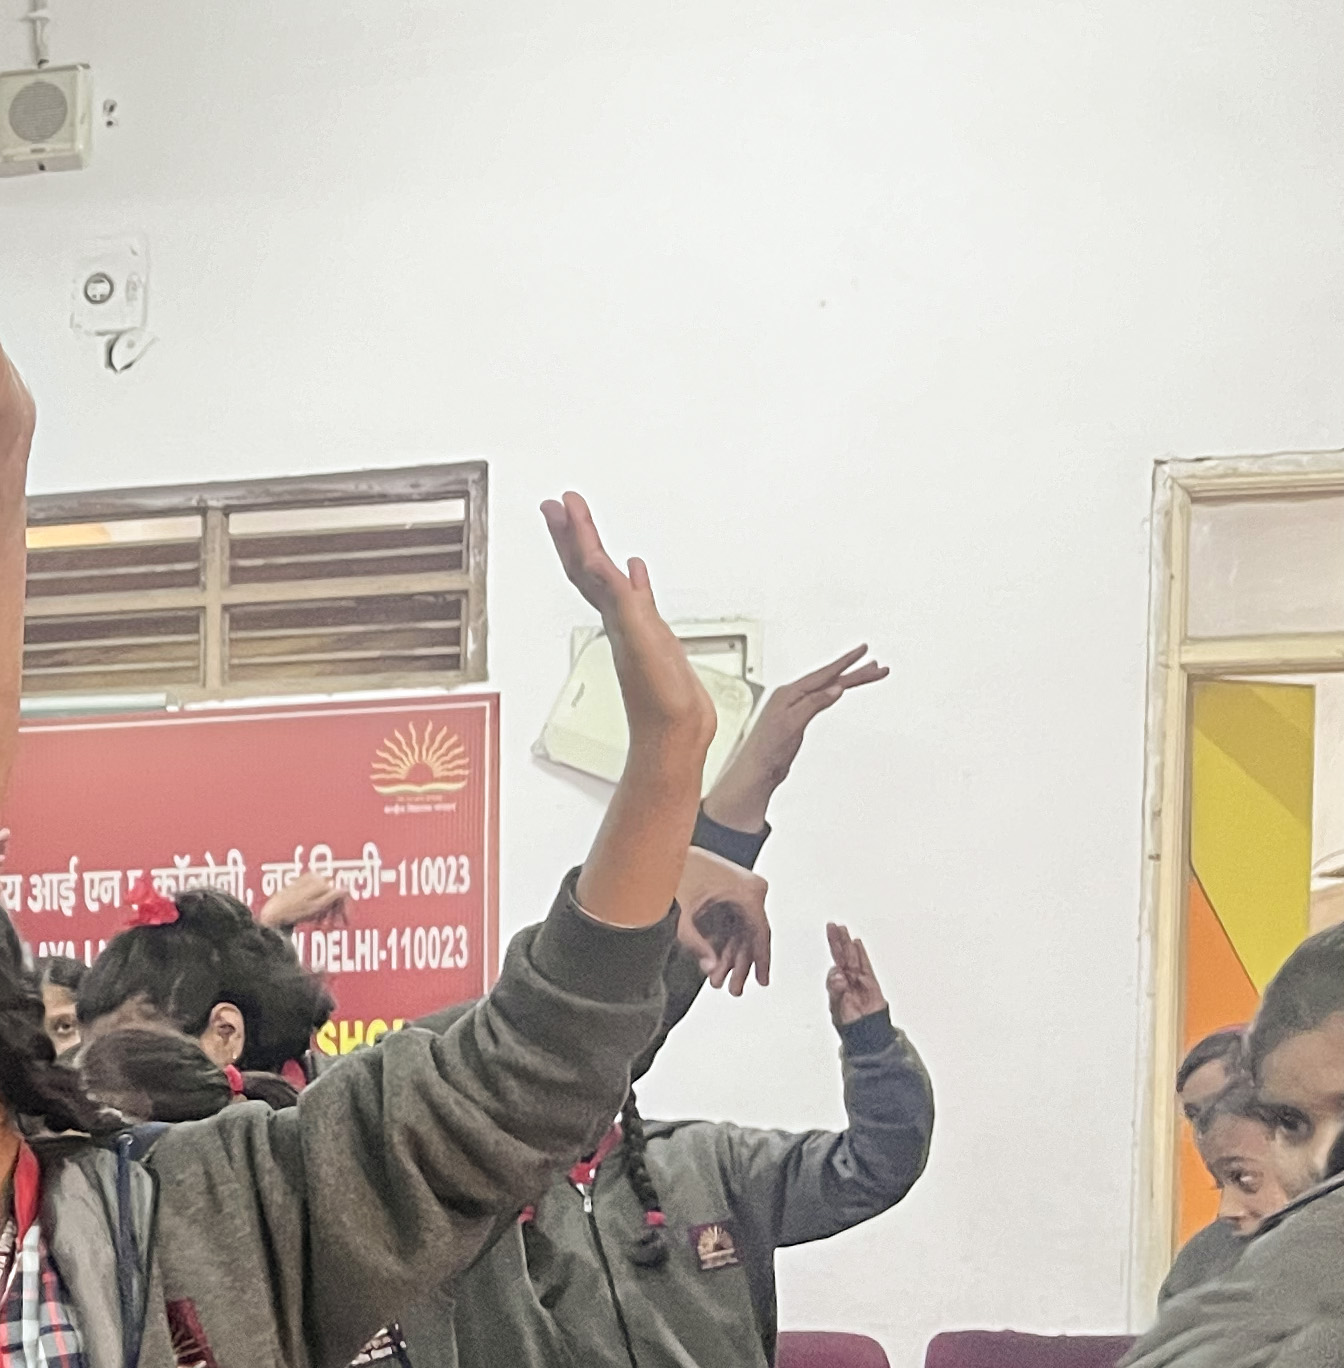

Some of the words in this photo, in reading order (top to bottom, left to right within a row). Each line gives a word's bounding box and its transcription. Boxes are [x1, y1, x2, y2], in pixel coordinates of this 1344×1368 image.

[27, 855, 79, 917] आई
[82, 870, 123, 912] एन
[310, 924, 469, 974] DELHI-110023
